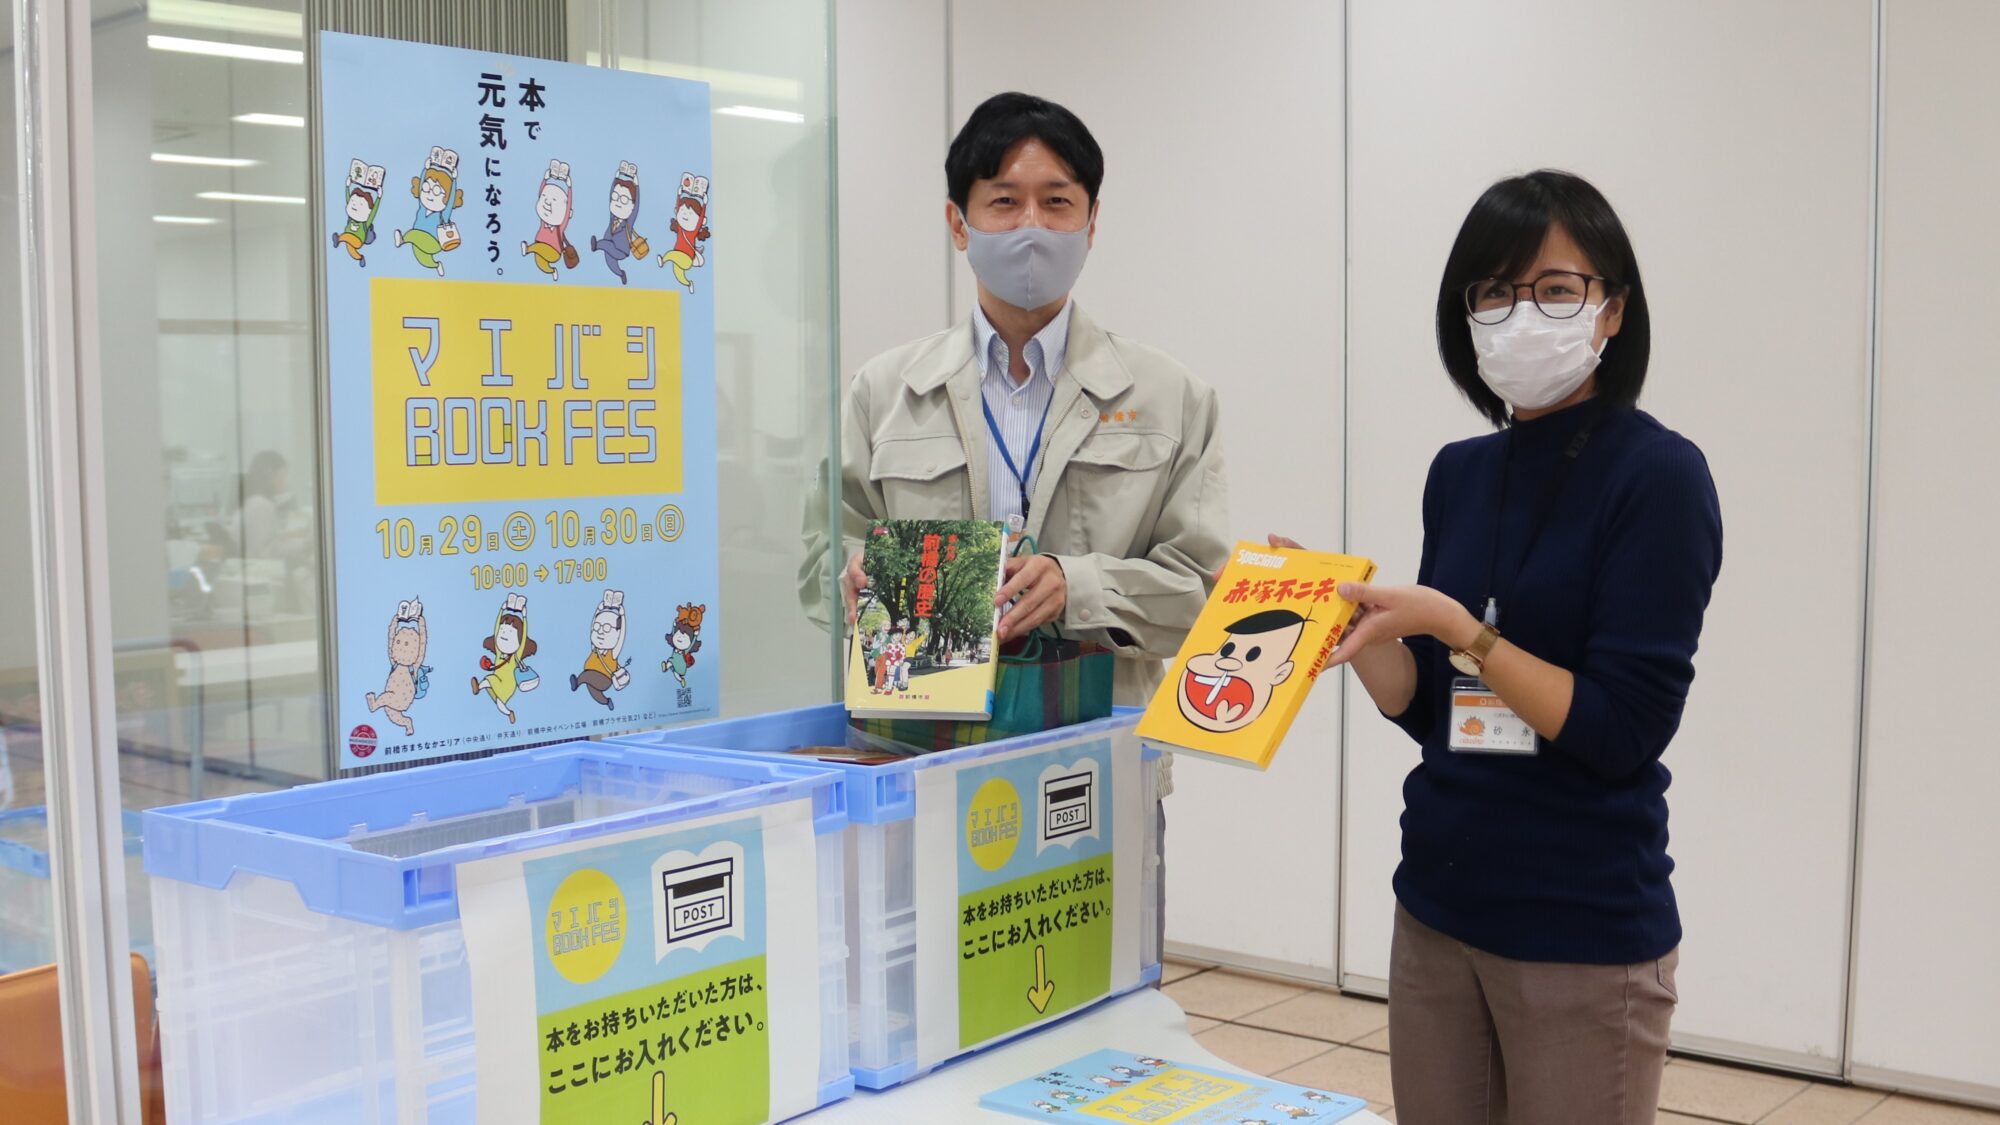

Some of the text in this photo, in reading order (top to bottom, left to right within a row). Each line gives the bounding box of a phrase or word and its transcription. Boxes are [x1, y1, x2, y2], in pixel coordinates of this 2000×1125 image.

[518, 77, 546, 140] 本で
[477, 72, 507, 276] 元気になろう。
[402, 316, 656, 390] マエバシ
[564, 400, 657, 465] FES
[470, 557, 607, 590] 10:00 17:00
[1236, 549, 1289, 569] Spectator
[1222, 577, 1336, 604] 赤塚不二夫
[1056, 809, 1080, 825] POST
[683, 903, 715, 924] POST
[963, 867, 1111, 926] 本をお持ちいただいた方は、
[592, 920, 621, 946] FES
[963, 900, 1111, 960] ここにお入れください。
[545, 973, 763, 1053] 本をお持ちいただいた方は、
[548, 1011, 765, 1094] ここにお入れください。
